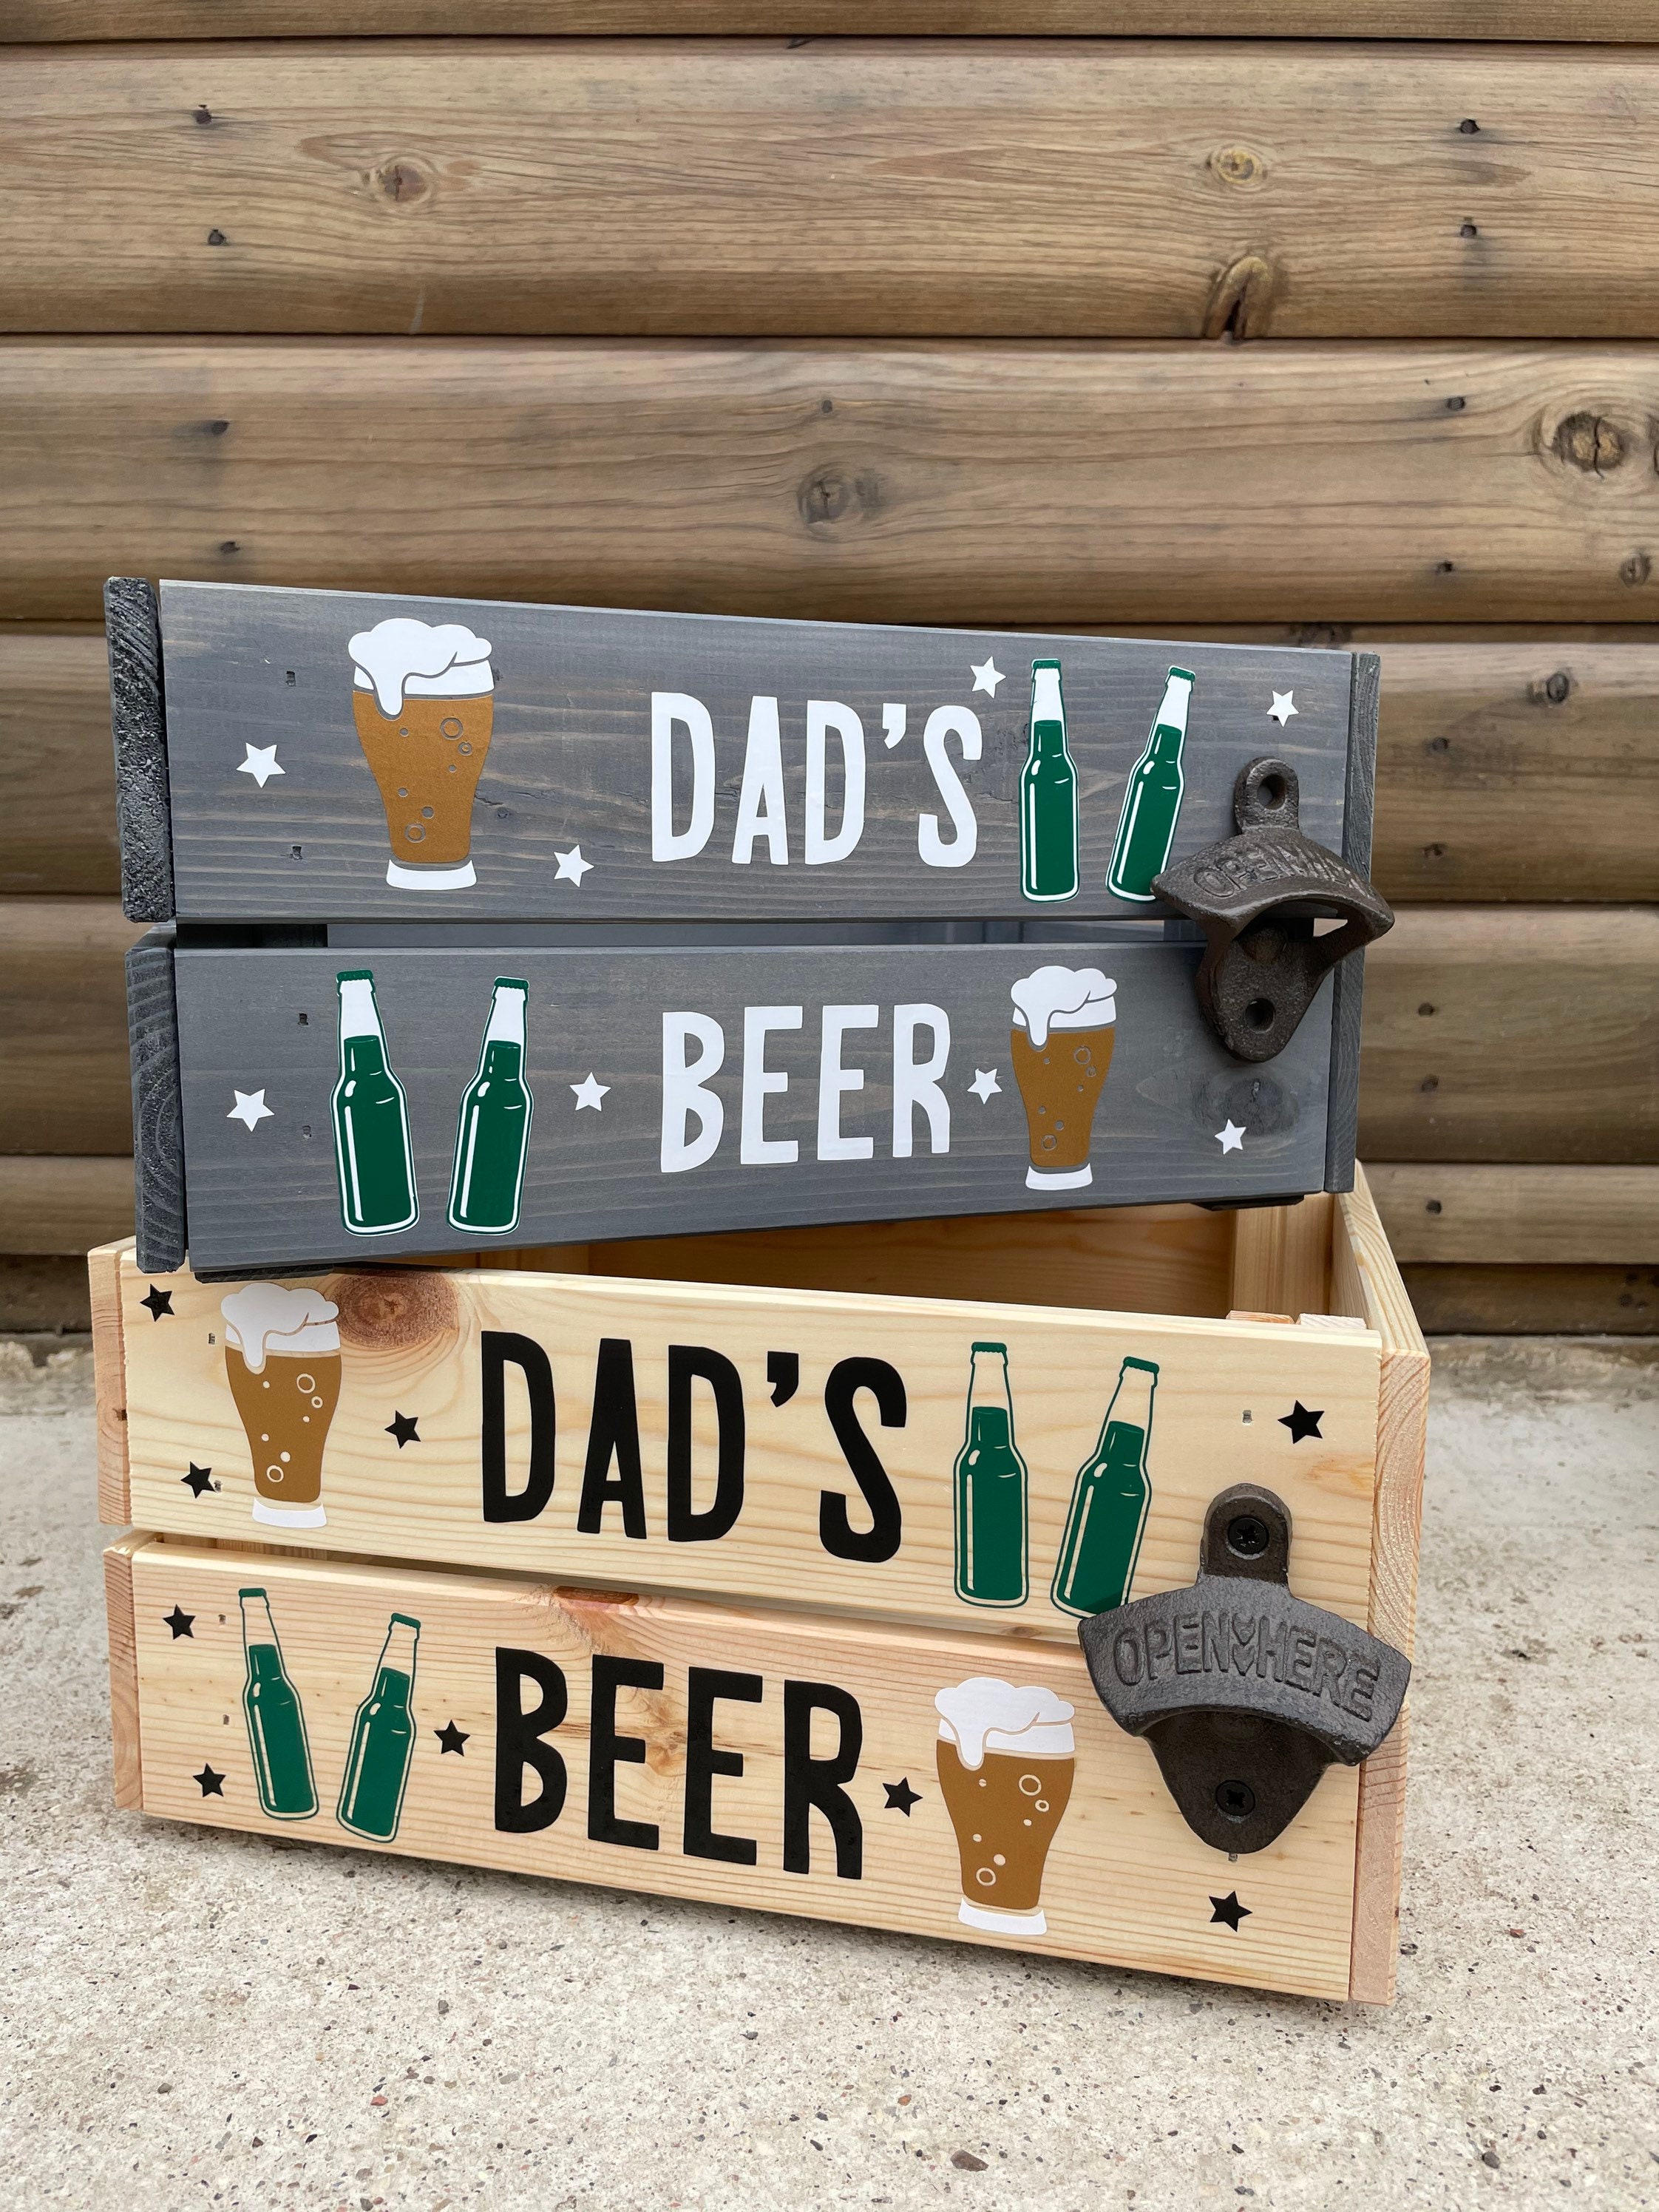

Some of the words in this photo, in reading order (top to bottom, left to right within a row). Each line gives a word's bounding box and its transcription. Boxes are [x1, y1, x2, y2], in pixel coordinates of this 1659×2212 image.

[651, 692, 983, 867] DAD'S
[661, 1004, 952, 1173] BEER
[481, 1331, 906, 1562] DAD'S
[1113, 1610, 1230, 1686] OPEN
[1256, 1615, 1380, 1722] HERE
[495, 1647, 864, 1880] BEER
